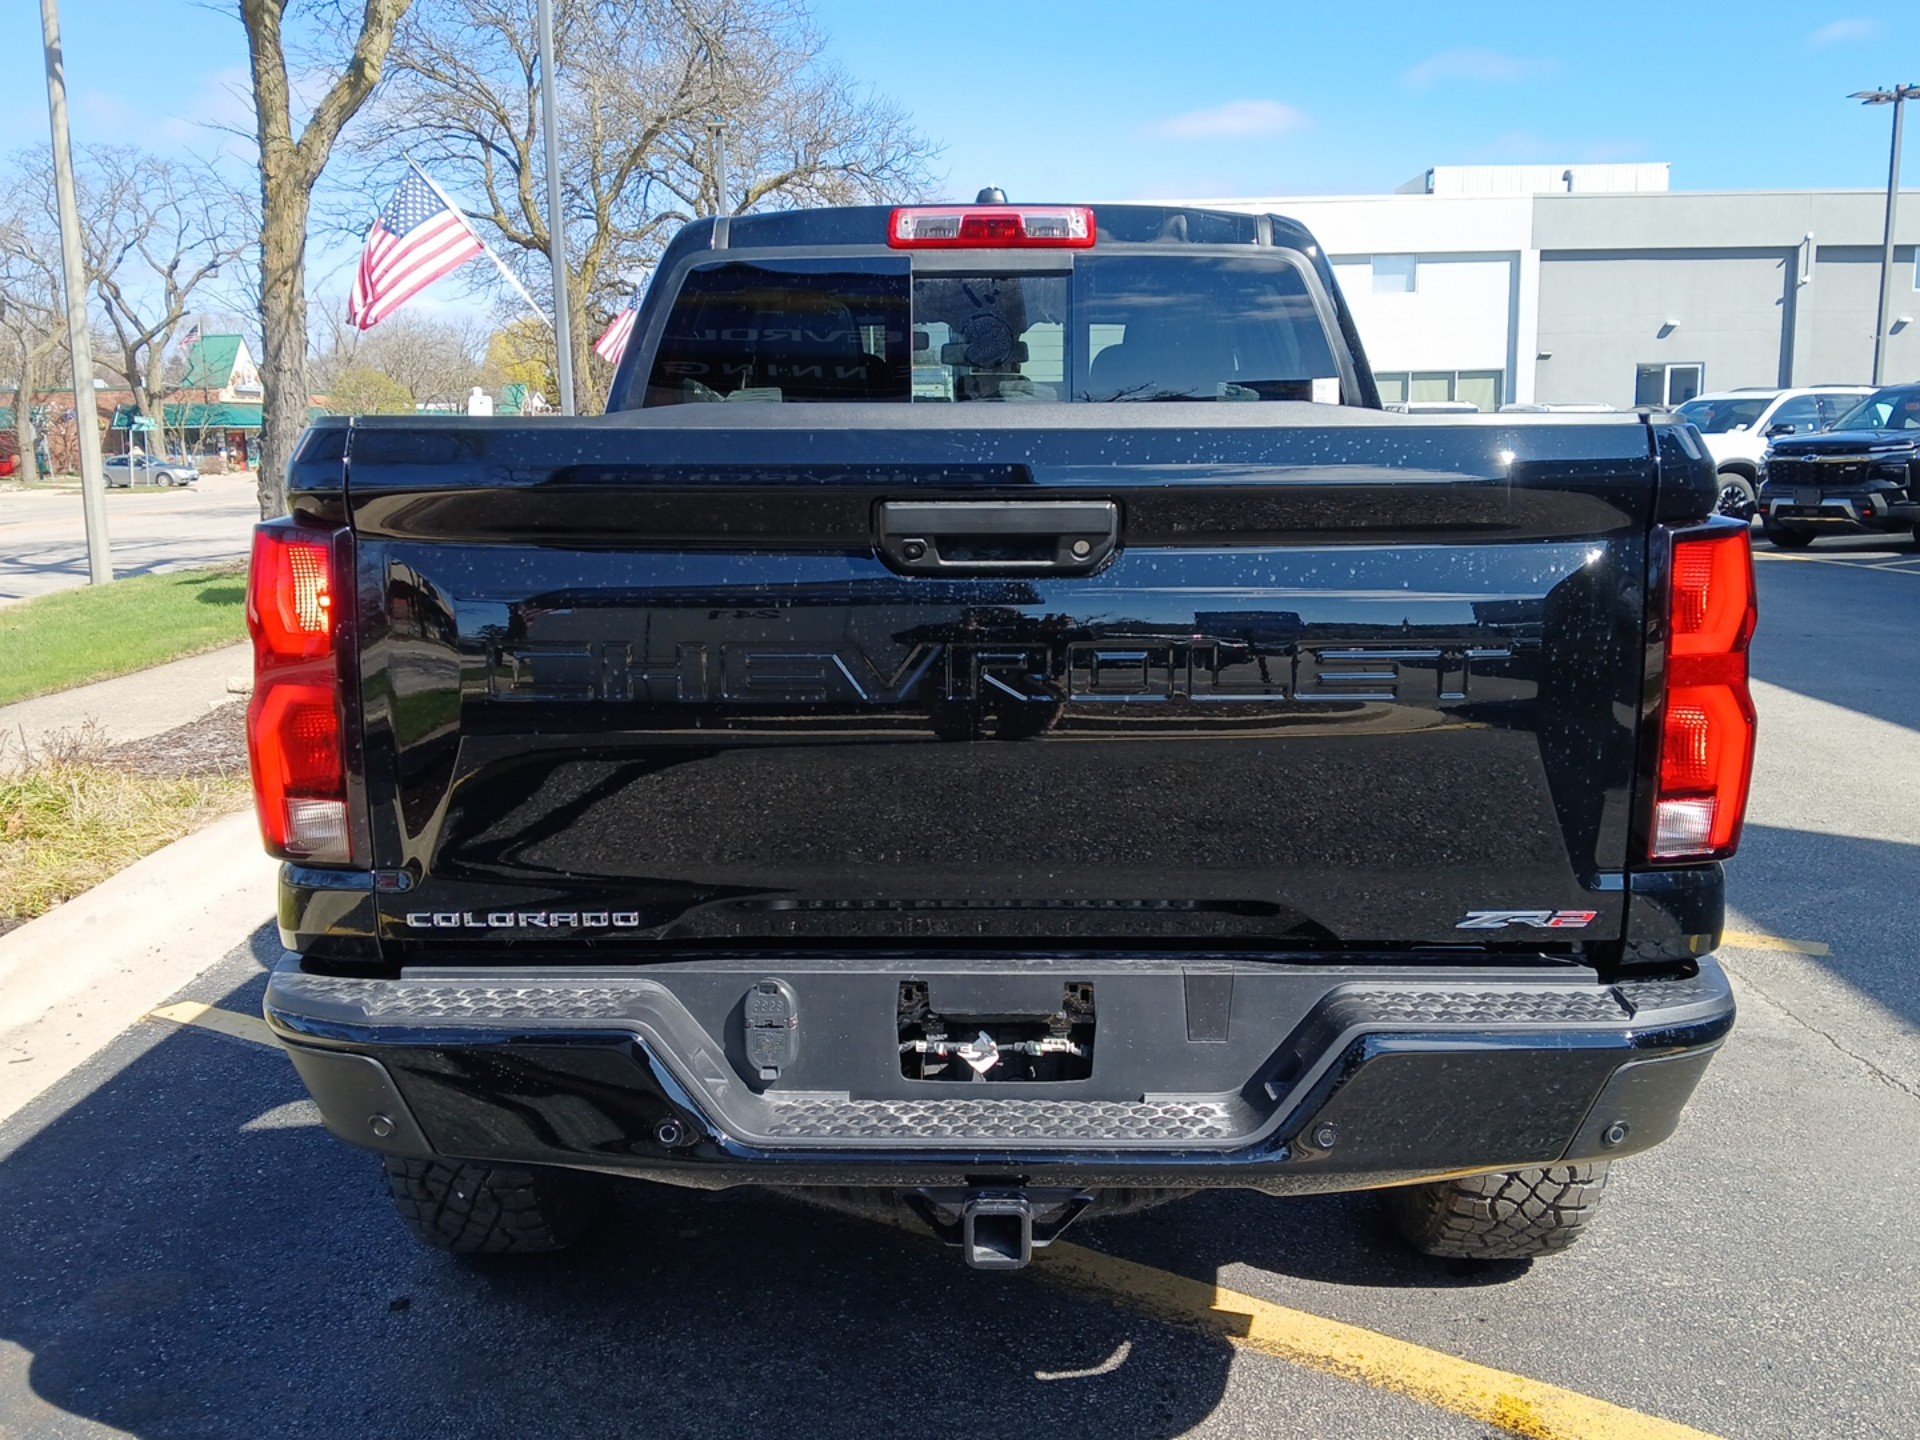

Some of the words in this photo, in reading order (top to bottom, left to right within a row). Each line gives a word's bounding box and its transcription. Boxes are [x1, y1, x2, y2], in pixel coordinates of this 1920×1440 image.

[490, 641, 1514, 702] CHEVROLET
[406, 912, 639, 928] COLORADO
[1455, 911, 1598, 928] ZR2
